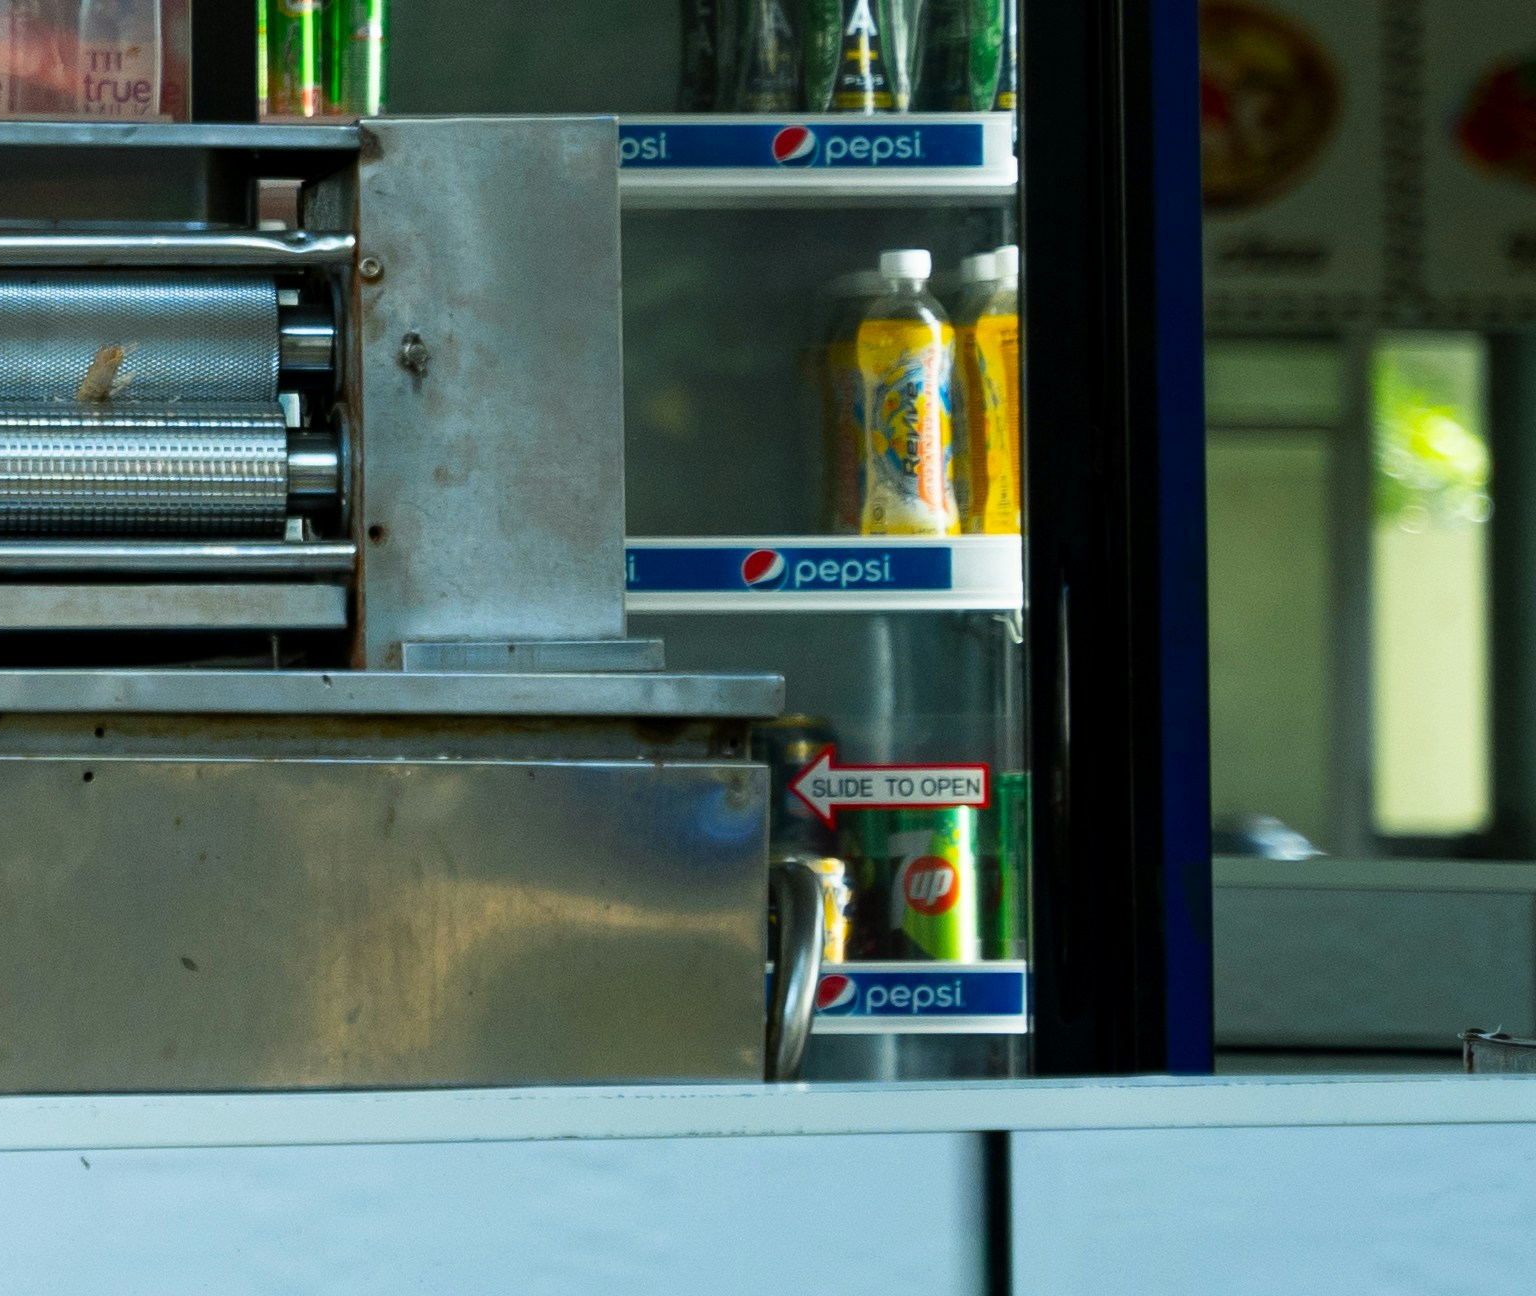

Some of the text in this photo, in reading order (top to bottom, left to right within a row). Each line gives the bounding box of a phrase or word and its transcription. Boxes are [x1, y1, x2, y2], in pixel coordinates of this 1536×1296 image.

[89, 50, 123, 71] TH
[84, 73, 152, 103] true
[828, 131, 921, 165] pepsi
[795, 554, 890, 589] pepsi
[813, 777, 981, 798] SLIDE TO OPEN
[866, 981, 963, 1015] pepsi
